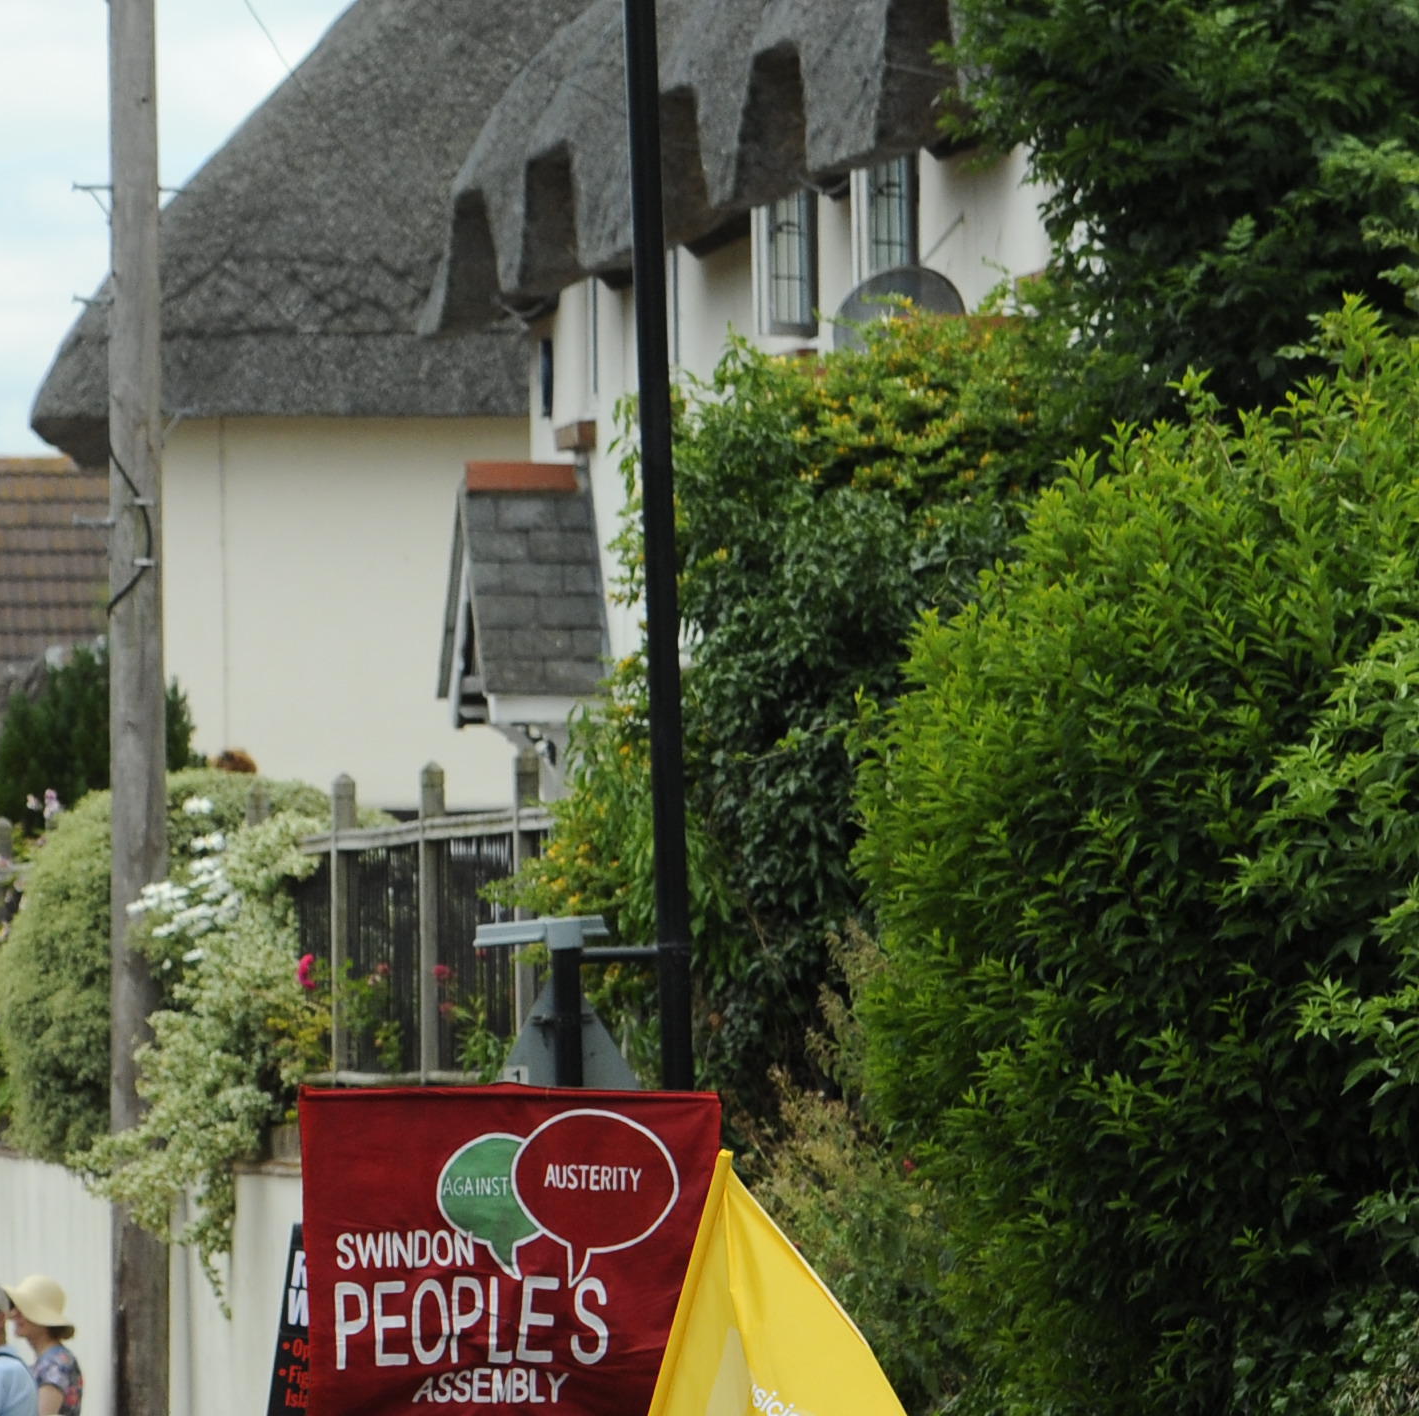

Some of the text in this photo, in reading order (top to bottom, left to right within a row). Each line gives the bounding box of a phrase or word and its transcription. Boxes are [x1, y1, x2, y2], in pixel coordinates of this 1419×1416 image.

[442, 1176, 509, 1197] AGAINST
[543, 1163, 642, 1193] AUSTERITY
[335, 1229, 474, 1270] SWINDON
[412, 1367, 570, 1404] ASSEMBLY
